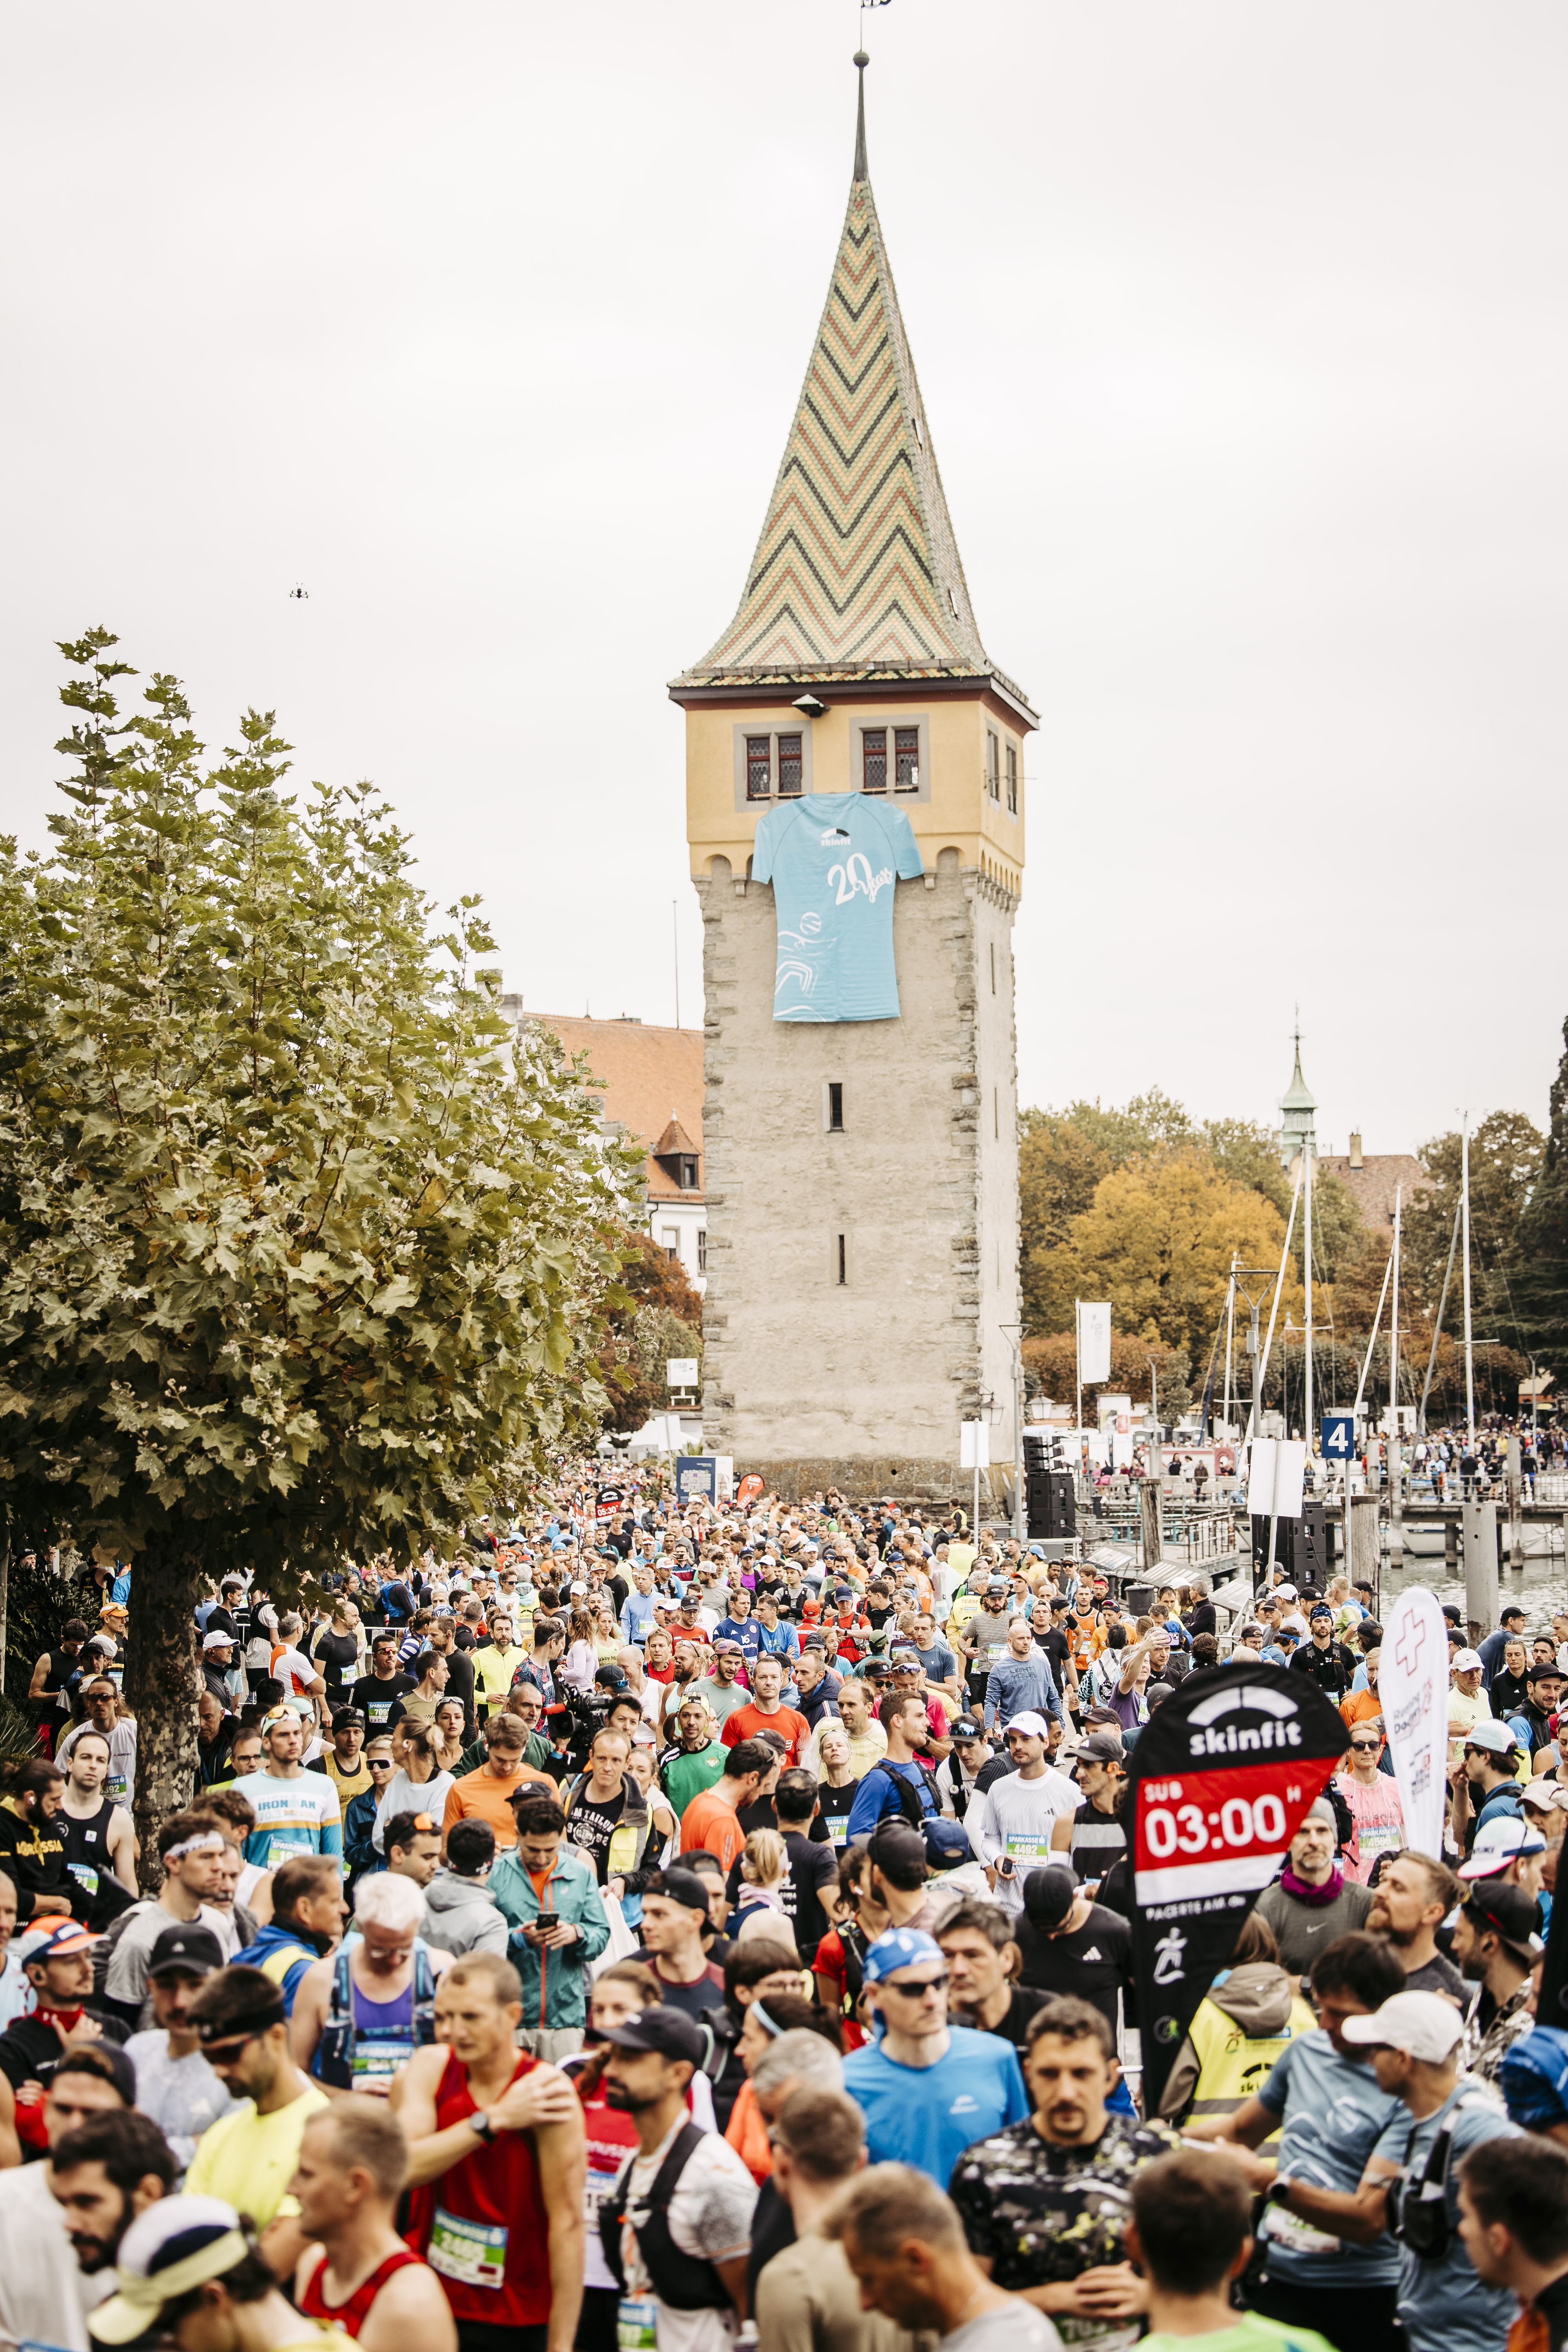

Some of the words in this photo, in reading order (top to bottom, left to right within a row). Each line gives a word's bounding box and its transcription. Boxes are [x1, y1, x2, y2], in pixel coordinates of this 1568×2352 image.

[820, 838, 851, 847] skinfit
[827, 853, 873, 906] 20
[1328, 1423, 1348, 1452] 4
[597, 1506, 617, 1516] 05:30
[1189, 1723, 1303, 1756] skinfit
[1144, 1780, 1183, 1803] SUB
[1287, 1786, 1301, 1803] H
[1144, 1794, 1287, 1858] 03:00
[1360, 1828, 1391, 1837] SPARKASSE
[1009, 1836, 1039, 1844] SPARKASSE
[1014, 1844, 1038, 1855] 4492
